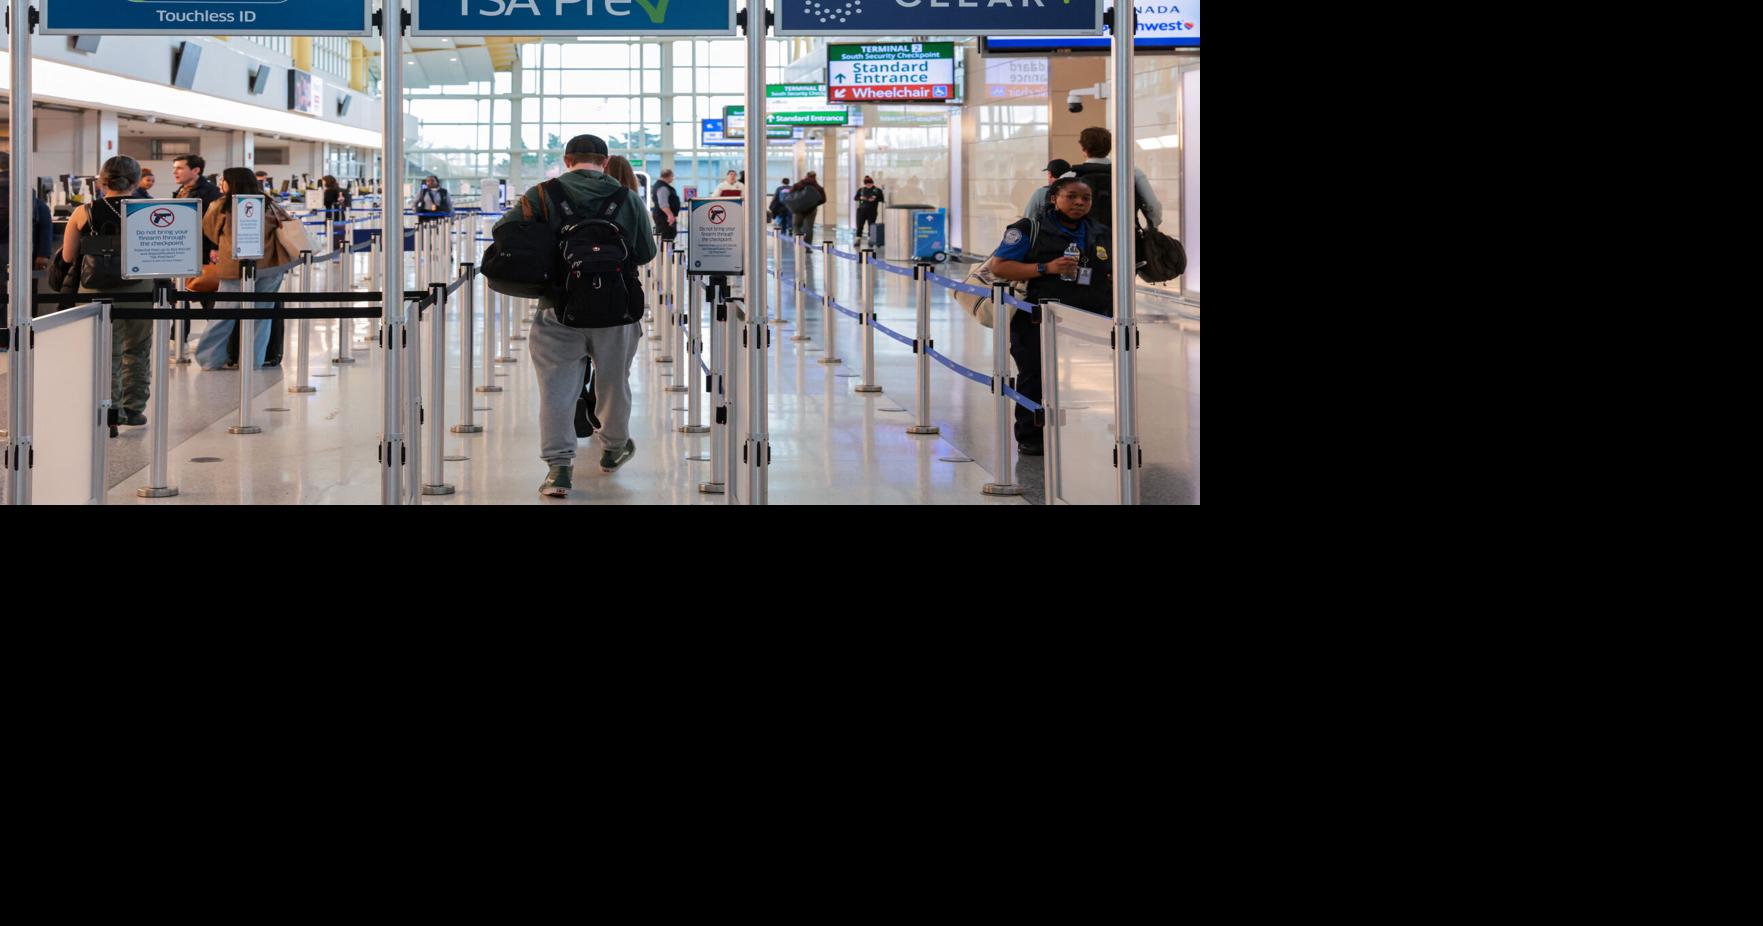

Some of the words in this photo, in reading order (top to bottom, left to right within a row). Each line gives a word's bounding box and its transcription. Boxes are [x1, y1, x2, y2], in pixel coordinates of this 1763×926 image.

[156, 10, 235, 22] Touchless
[239, 10, 257, 22] ID
[861, 45, 909, 53] TERMINAL
[912, 44, 922, 52] 2
[865, 52, 896, 60] Security
[853, 61, 928, 73] Standard
[854, 73, 928, 84] Entrance
[852, 86, 930, 98] Wheelchair
